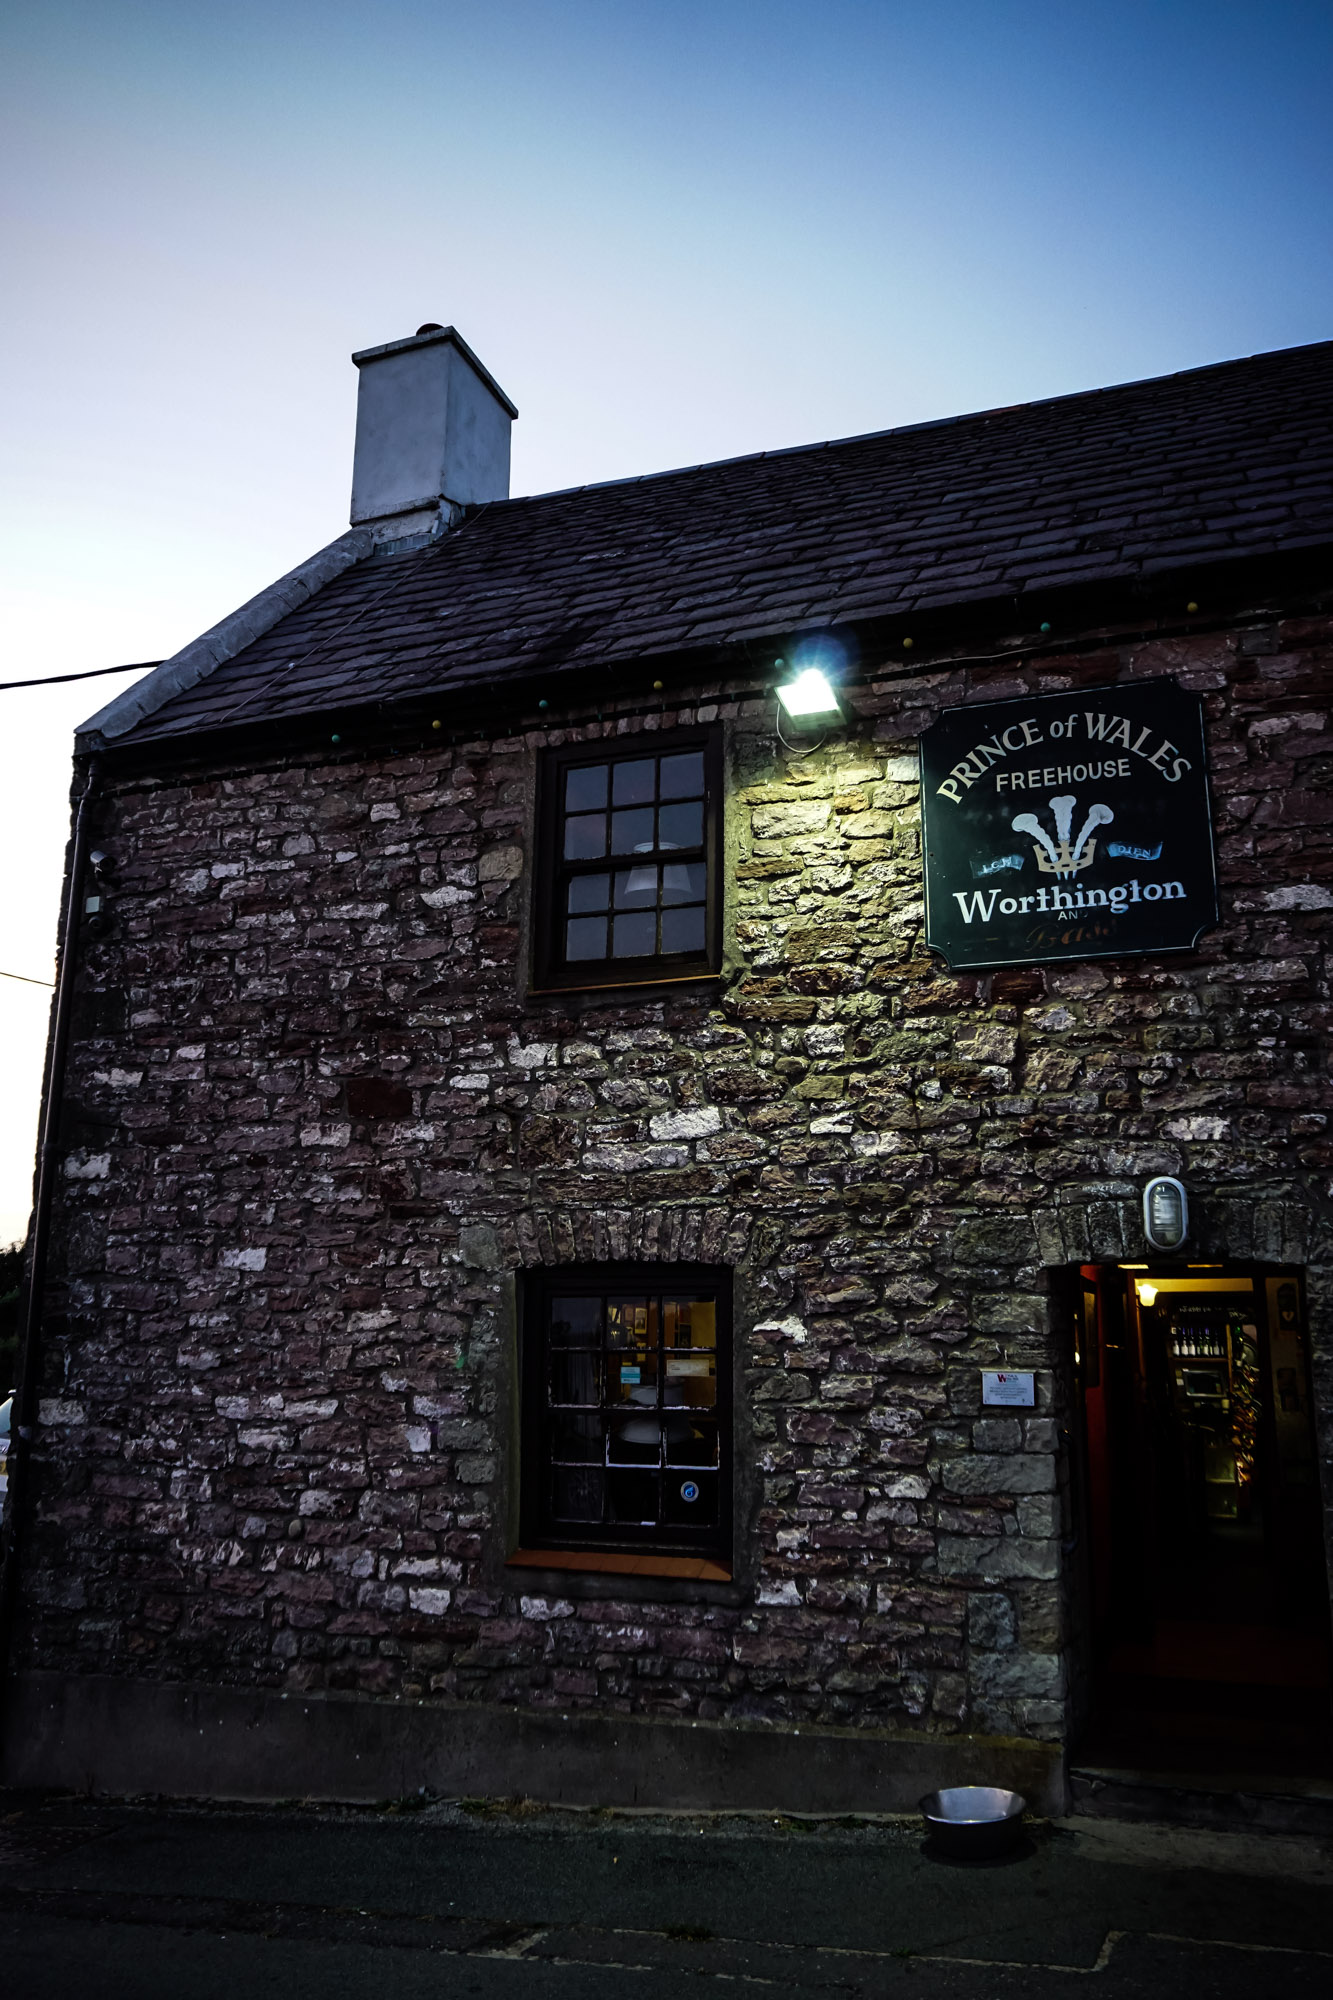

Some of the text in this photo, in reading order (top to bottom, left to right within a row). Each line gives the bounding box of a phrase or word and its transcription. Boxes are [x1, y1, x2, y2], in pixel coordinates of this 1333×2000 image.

[936, 712, 1192, 805] PRINCE of WALES
[996, 758, 1131, 792] FREEHOUSE
[952, 878, 1188, 924] Worthington
